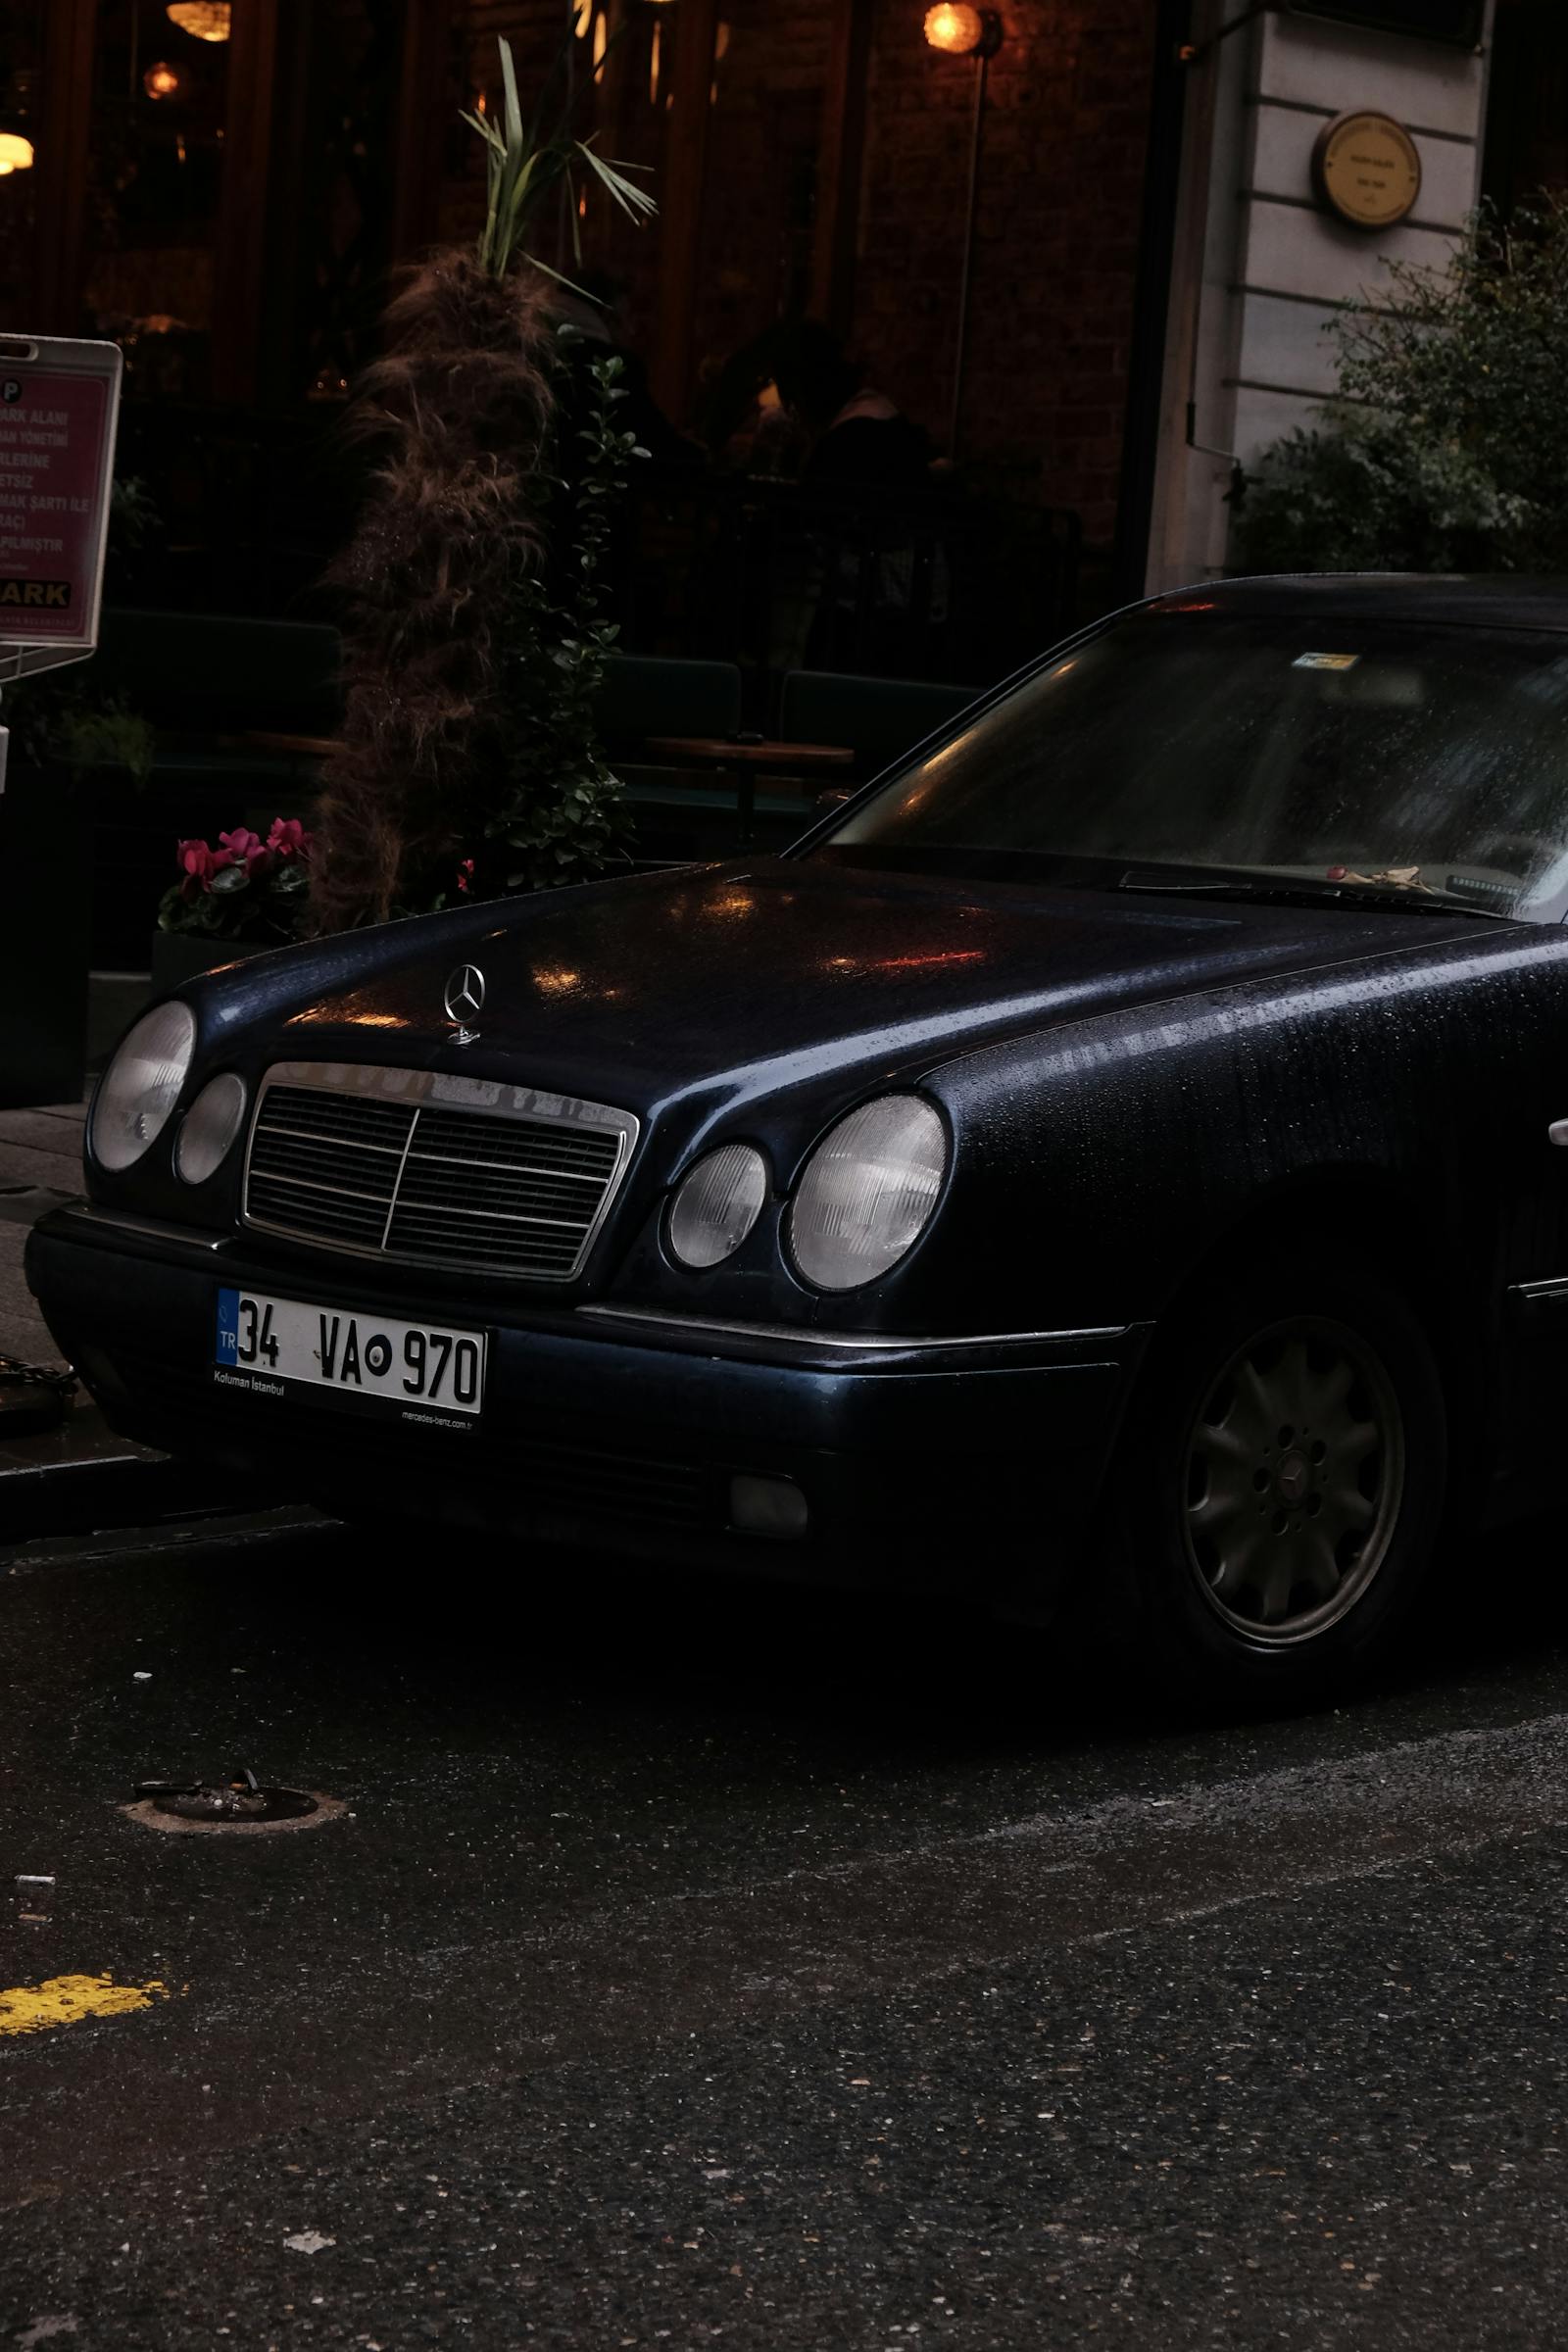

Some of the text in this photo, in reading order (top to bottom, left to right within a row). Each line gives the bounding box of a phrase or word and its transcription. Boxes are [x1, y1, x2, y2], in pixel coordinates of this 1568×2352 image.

[3, 381, 20, 400] P
[0, 408, 69, 425] ARK ALANI
[30, 495, 67, 513] ŞARTI
[220, 1331, 236, 1349] TR
[239, 1299, 477, 1403] 34 VA 970
[214, 1371, 250, 1388] Koluman
